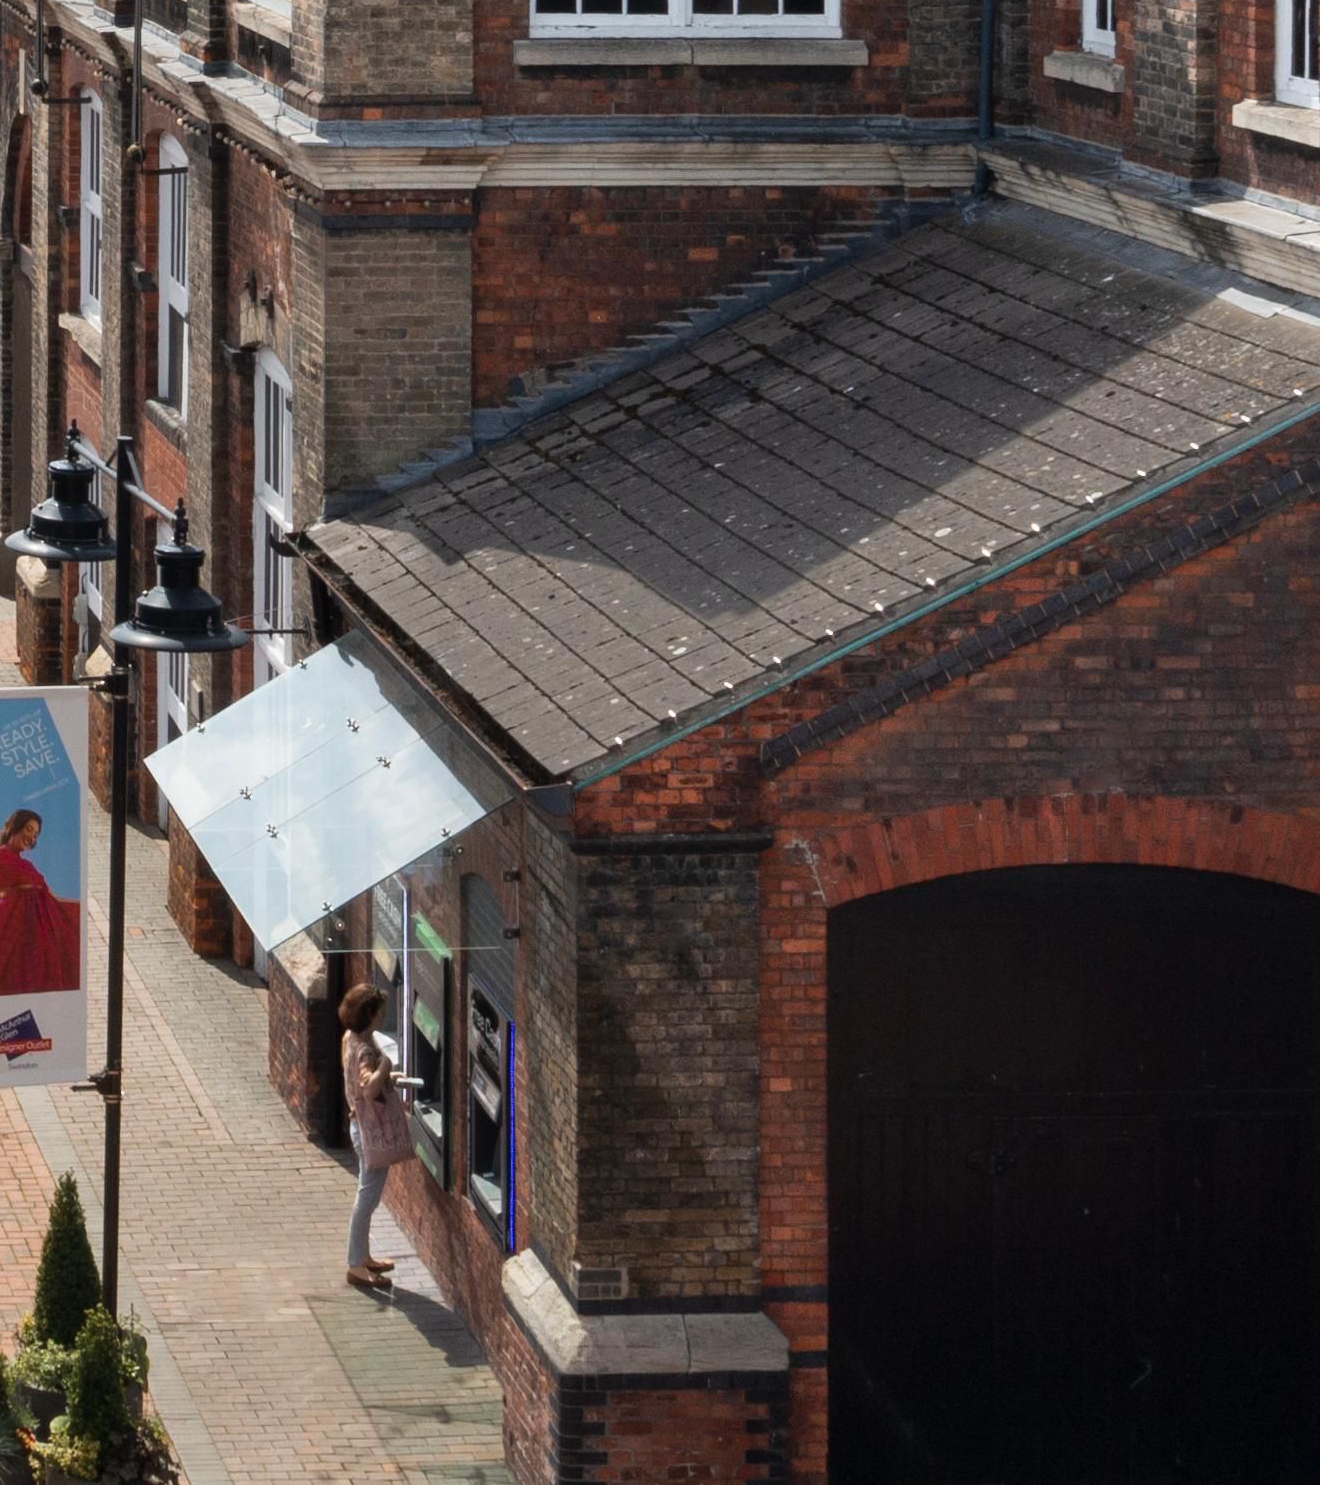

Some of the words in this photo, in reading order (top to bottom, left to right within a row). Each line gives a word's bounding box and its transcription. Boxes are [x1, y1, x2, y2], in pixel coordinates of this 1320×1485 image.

[0, 733, 55, 767] STYLE.
[14, 748, 61, 779] SAVE.
[0, 1029, 19, 1042] Glen
[26, 1040, 51, 1050] Outlet
